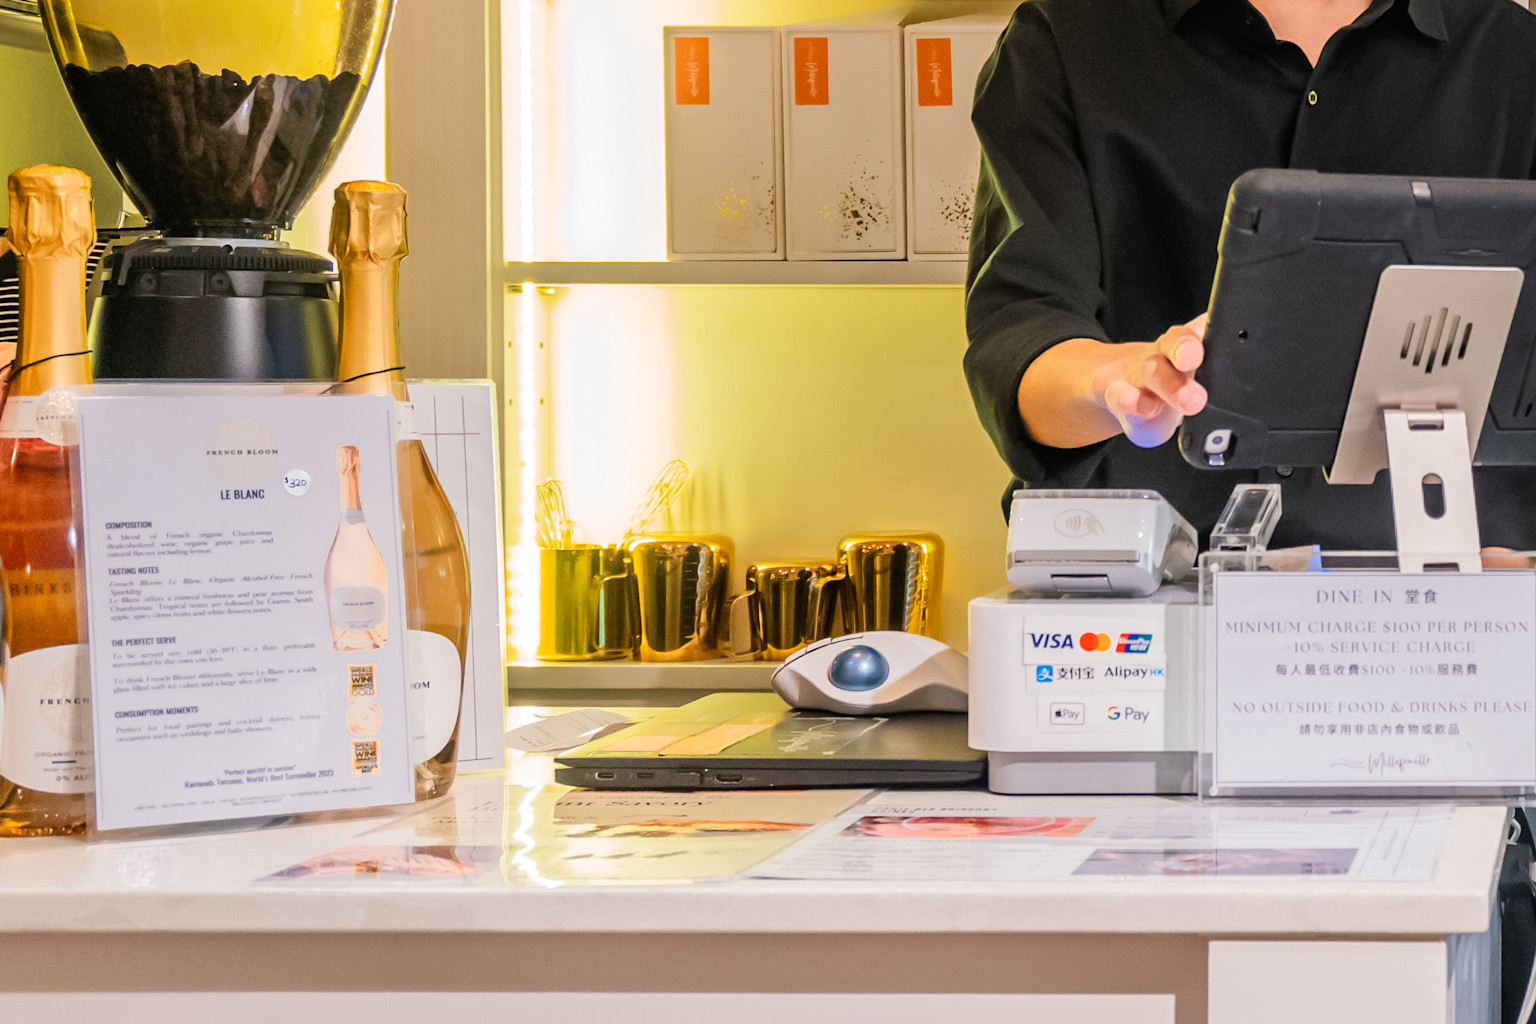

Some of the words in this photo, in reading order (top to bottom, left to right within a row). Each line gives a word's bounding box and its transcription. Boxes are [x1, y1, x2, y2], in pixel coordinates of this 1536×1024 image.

[284, 476, 307, 488] $320
[220, 489, 231, 500] LE
[233, 488, 265, 499] BLANC
[105, 521, 152, 529] COMPOSITION
[138, 566, 159, 574] NOTES
[1316, 588, 1363, 604] DINE
[1373, 588, 1393, 604] IN
[1404, 588, 1438, 605] 堂食
[1225, 620, 1301, 634] MINIMUM
[1307, 620, 1377, 634] CHARGE
[1427, 620, 1457, 633] PER
[1463, 619, 1529, 633] PERSON
[111, 639, 124, 647] THE
[126, 637, 154, 646] PERFECT
[155, 636, 177, 644] SERVE
[1027, 632, 1074, 649] VISA
[1330, 640, 1401, 654] SERVICE
[1407, 640, 1476, 654] CHARGE
[351, 676, 374, 684] WINE
[1057, 666, 1095, 681] 支付宝
[40, 697, 90, 705] FRENCH
[1233, 701, 1256, 713] NO
[1261, 701, 1333, 713] OUTSIDE
[1338, 701, 1385, 713] FOOD
[1390, 701, 1404, 713] &
[1410, 701, 1468, 713] DRINKS
[1474, 701, 1533, 713] PLEASE
[114, 708, 164, 719] CONSUMPTION
[166, 705, 199, 715] MOMENTS
[1063, 708, 1081, 721] Pay
[1106, 706, 1121, 721] G
[1125, 706, 1150, 724] Pay
[1367, 751, 1432, 777] Millefeuille
